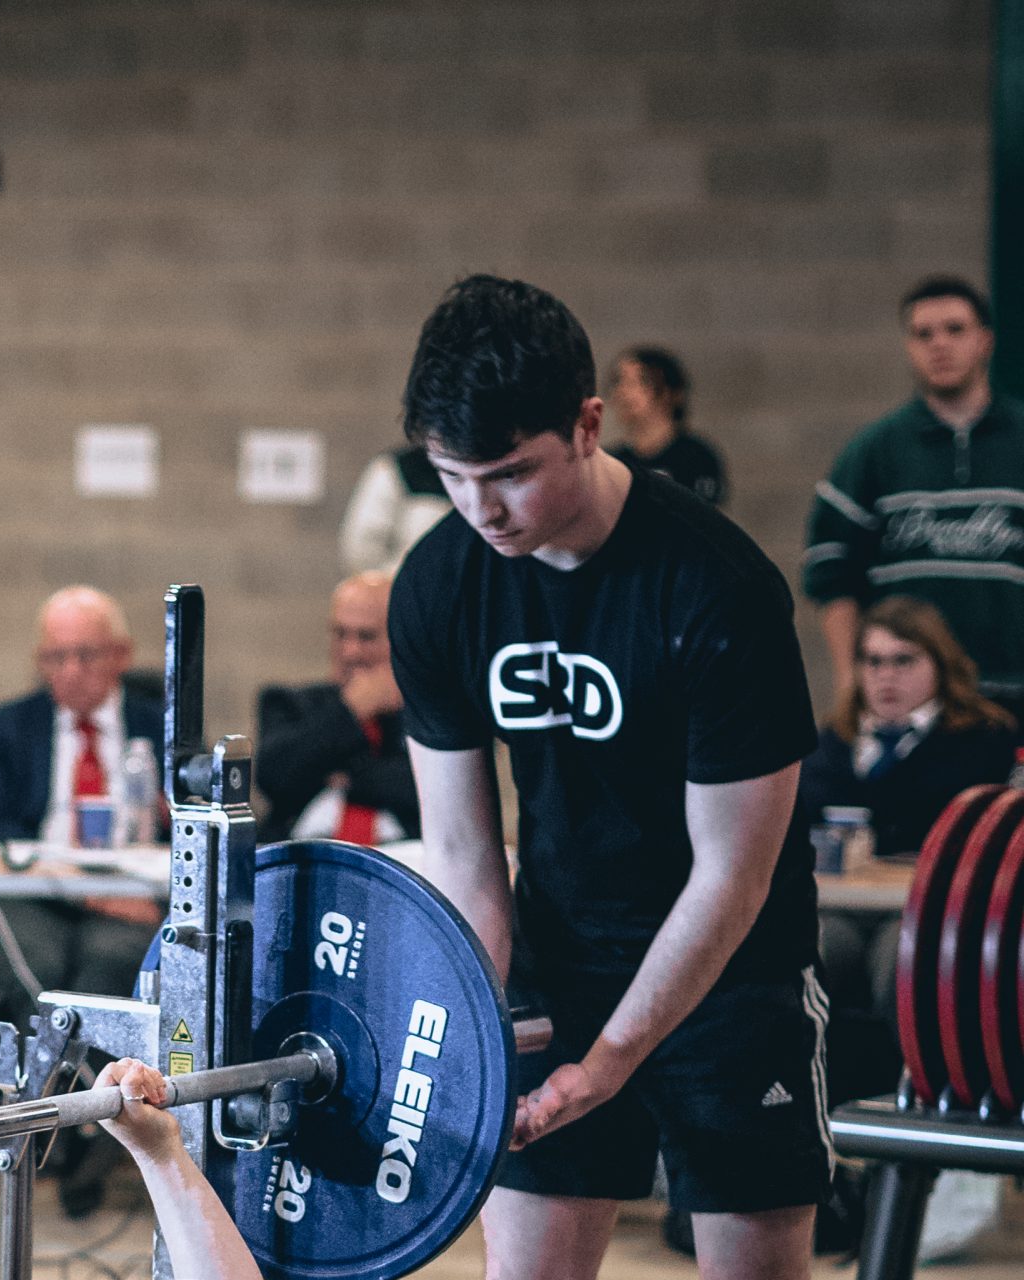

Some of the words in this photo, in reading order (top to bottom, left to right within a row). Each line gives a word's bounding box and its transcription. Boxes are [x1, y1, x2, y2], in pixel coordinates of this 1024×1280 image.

[175, 850, 181, 860] 2
[175, 876, 181, 886] 3
[314, 911, 353, 976] 20
[347, 921, 366, 979] SWEDEN
[376, 999, 449, 1203] ELEIKO
[262, 1155, 281, 1212] SWEDEN
[274, 1160, 312, 1223] 20
